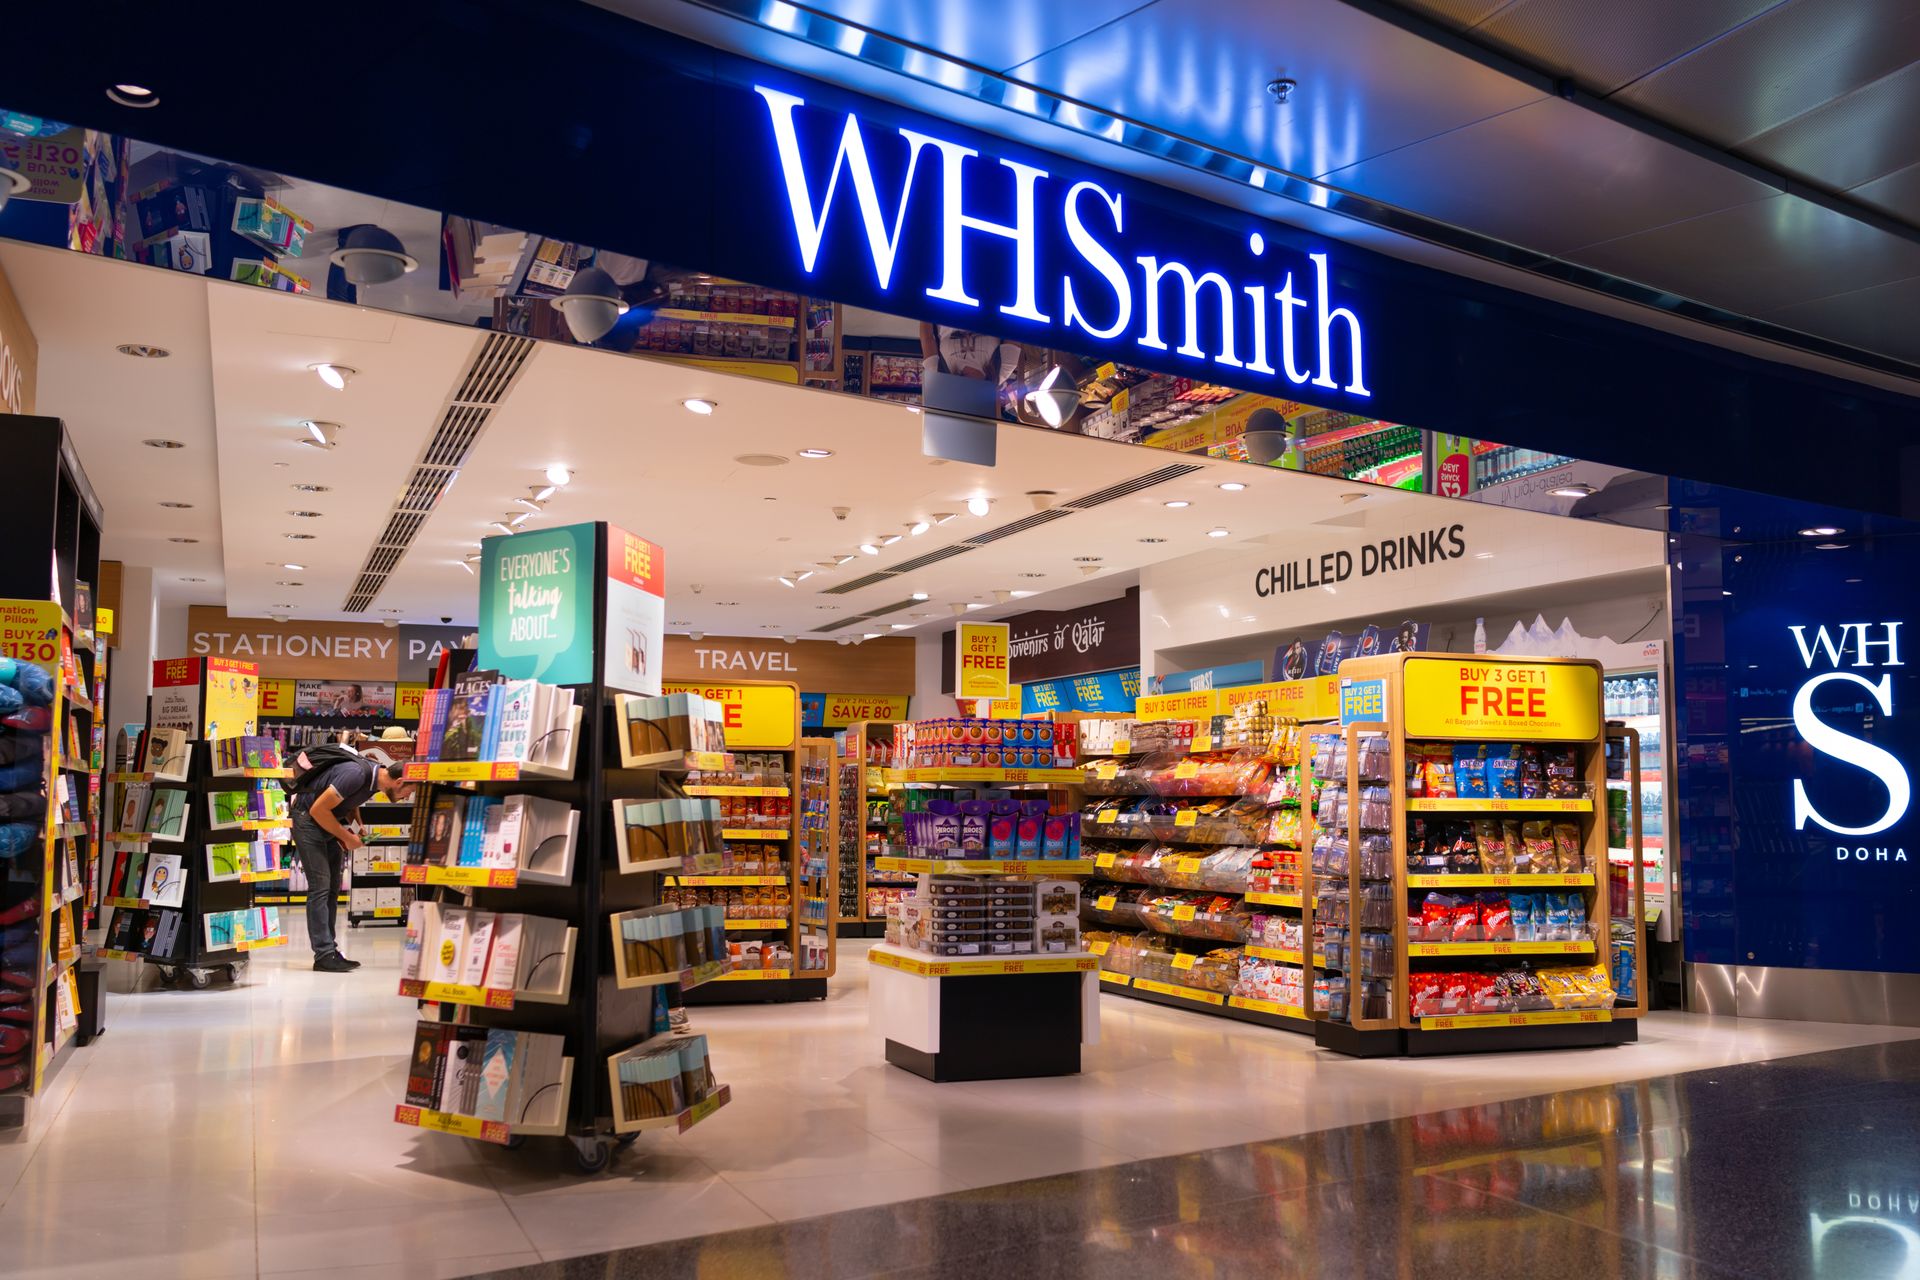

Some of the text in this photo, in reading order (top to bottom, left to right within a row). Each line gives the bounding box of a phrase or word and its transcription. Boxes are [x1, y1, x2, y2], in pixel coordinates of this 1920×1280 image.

[754, 84, 1371, 397] WHSmith
[0, 330, 22, 414] OKS
[501, 548, 570, 581] EVERYONE'S
[624, 547, 651, 579] FREE
[1255, 523, 1465, 598] CHILLED DRINKS
[508, 582, 563, 619] talking
[4, 615, 38, 624] Pillow
[4, 629, 45, 640] BUY 2
[1072, 616, 1105, 653] Qatar
[9, 642, 56, 661] 130
[193, 632, 393, 660] STATIONERY
[1788, 622, 1905, 669] WH
[213, 658, 224, 667] BUY
[242, 662, 254, 671] FREE
[694, 649, 797, 672] TRAVEL
[963, 655, 1006, 669] FREE
[166, 666, 188, 679] FREE
[1460, 668, 1546, 683] BUY 3 GET 1
[454, 679, 492, 695] PLACES
[705, 689, 732, 700] GET
[738, 690, 742, 700] 1
[1076, 684, 1104, 702] FREE
[1344, 686, 1357, 696] BUY
[1364, 685, 1376, 695] GET
[1034, 690, 1060, 708] FREE
[1229, 692, 1245, 706] BUY
[1279, 686, 1304, 700] FREE
[1460, 686, 1547, 717] FREE
[832, 705, 891, 719] SAVE 80
[994, 702, 1009, 710] SAVE
[1144, 702, 1158, 714] BUY
[1166, 699, 1181, 711] GET
[1187, 696, 1207, 709] FREE
[1344, 695, 1382, 716] FREE
[1455, 719, 1477, 728] Bagged
[1479, 719, 1501, 727] Sweets
[1529, 720, 1561, 728] Chocolates
[1793, 672, 1910, 835] S
[1005, 772, 1028, 781] FREE
[935, 826, 959, 834] HEROES
[1837, 847, 1907, 862] DOHA
[1003, 866, 1027, 874] FREE
[929, 967, 950, 975] FREE
[1436, 1020, 1454, 1028] FREE
